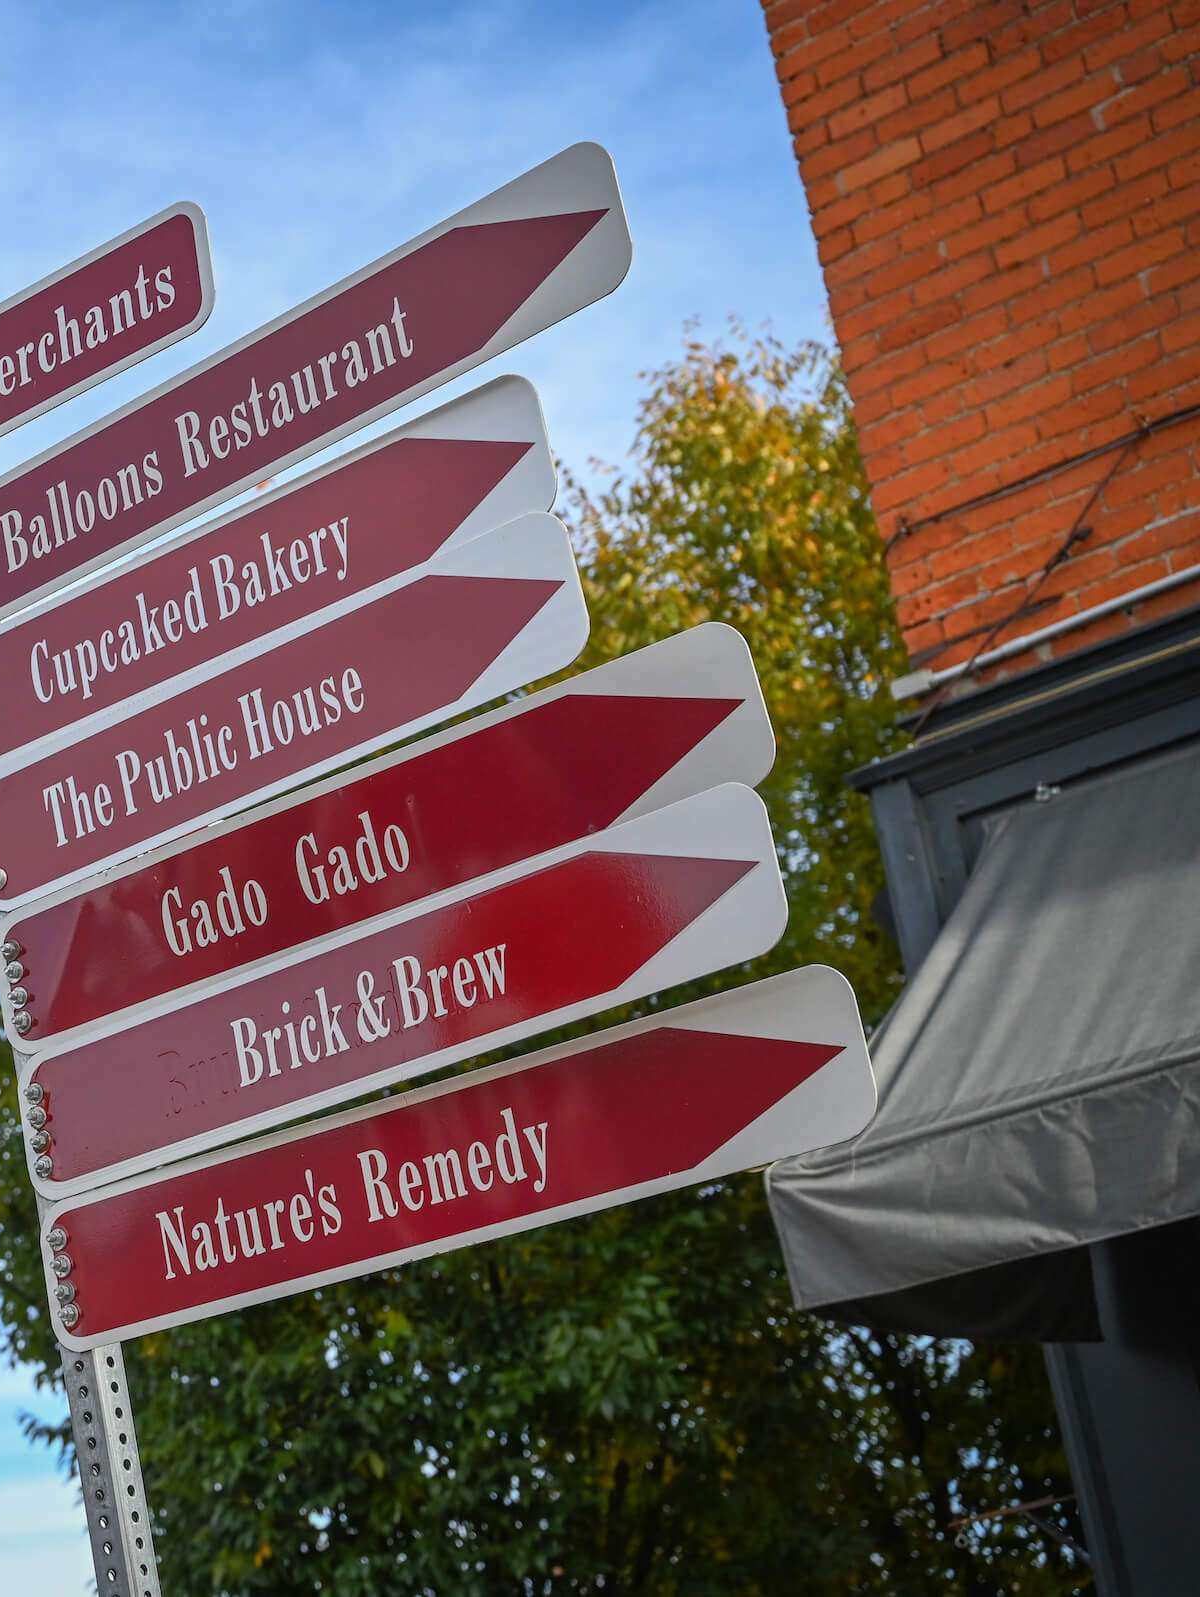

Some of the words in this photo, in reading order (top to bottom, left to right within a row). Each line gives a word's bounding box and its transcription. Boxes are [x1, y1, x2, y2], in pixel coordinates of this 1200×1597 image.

[174, 296, 414, 478] Restaurant
[30, 566, 208, 703] Cupcaked
[208, 516, 349, 621] Bakery
[42, 775, 114, 848] The
[114, 714, 237, 817] Public
[237, 667, 365, 761] House
[161, 866, 268, 956] Gado
[295, 810, 410, 904] Gado
[155, 1169, 342, 1280] Nature's
[356, 1107, 548, 1223] Remedy
